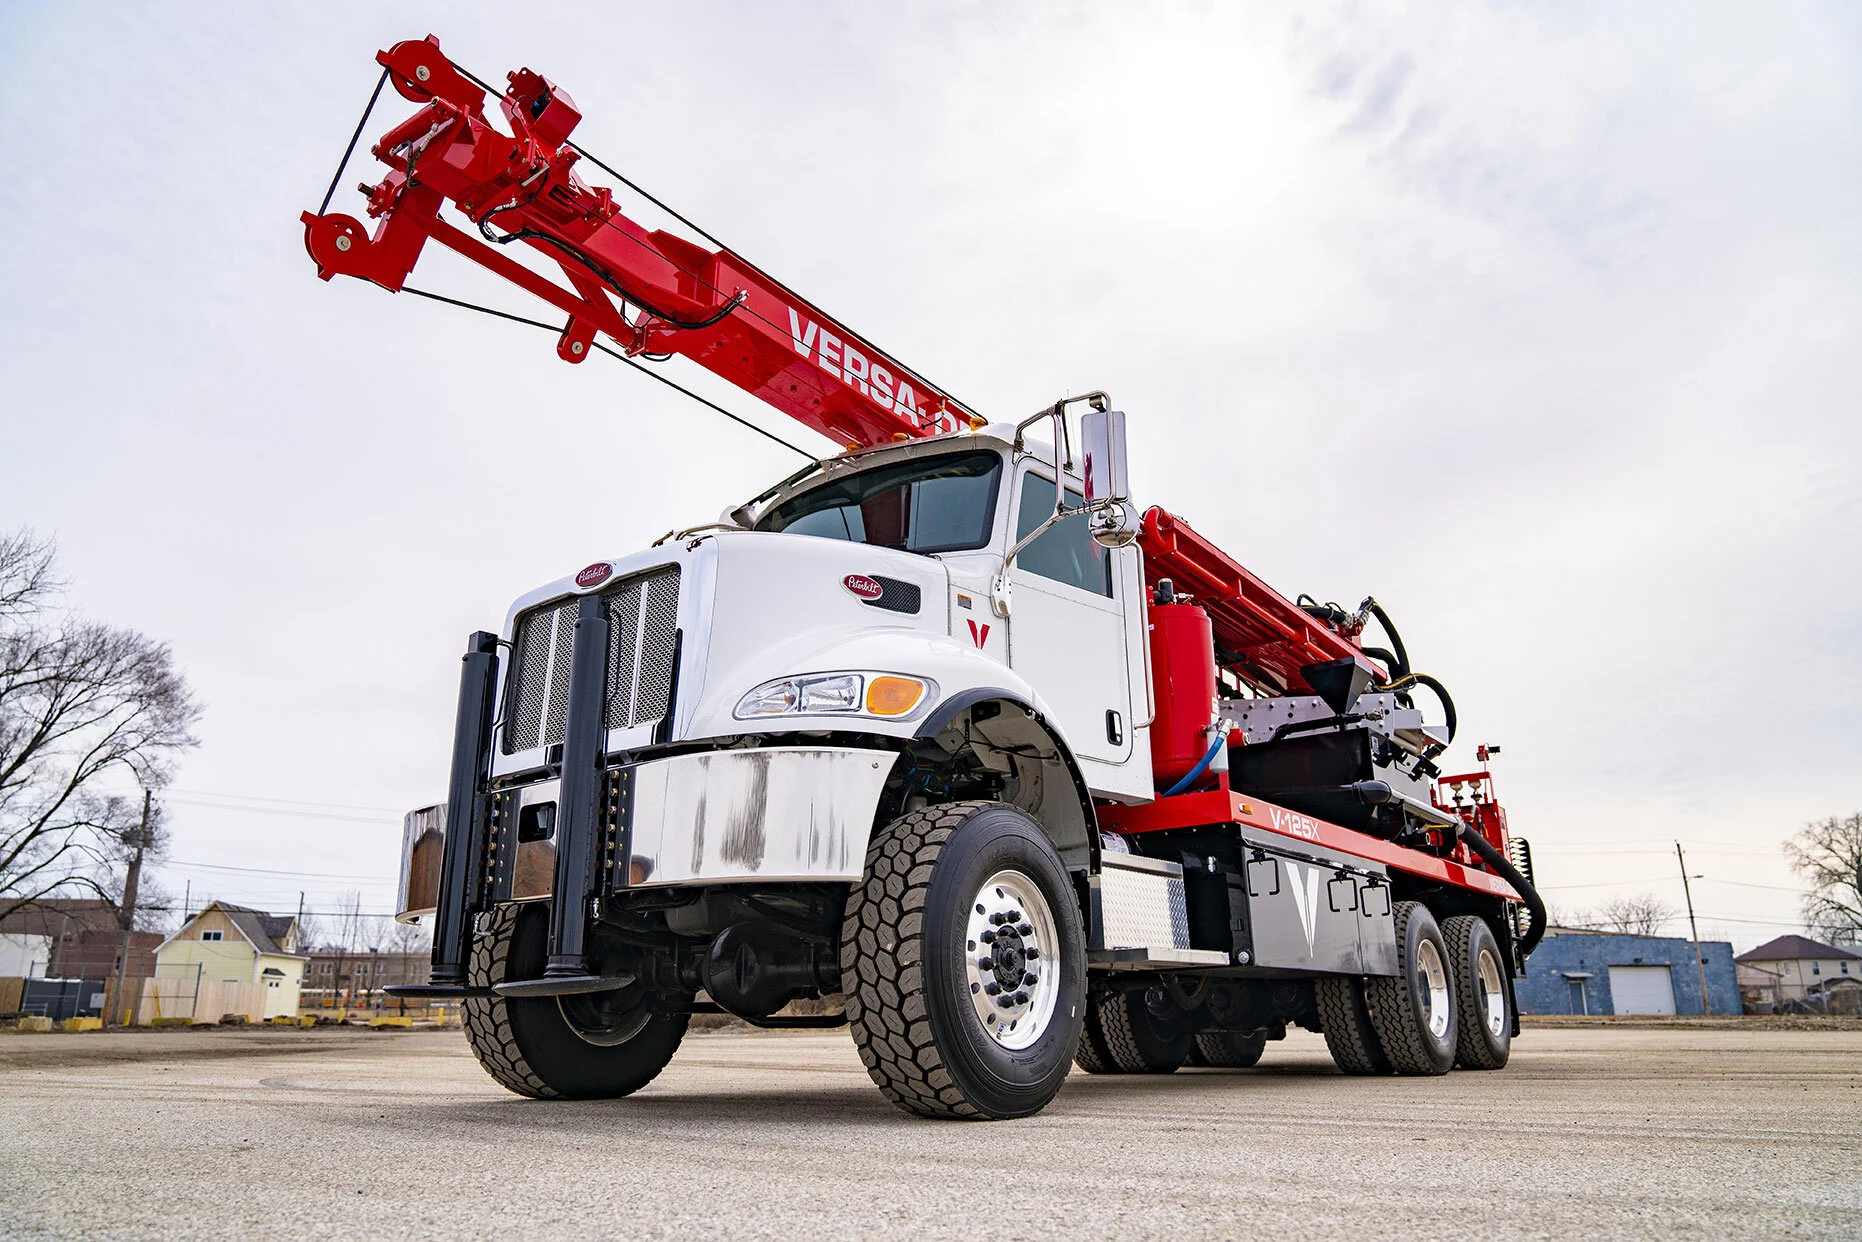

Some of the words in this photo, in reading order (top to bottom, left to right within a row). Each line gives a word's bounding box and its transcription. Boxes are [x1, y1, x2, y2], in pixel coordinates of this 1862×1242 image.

[788, 306, 970, 435] VERSA-D
[578, 564, 608, 583] Peterbilt
[848, 575, 879, 594] Peterbilt
[1269, 808, 1321, 842] V-125X
